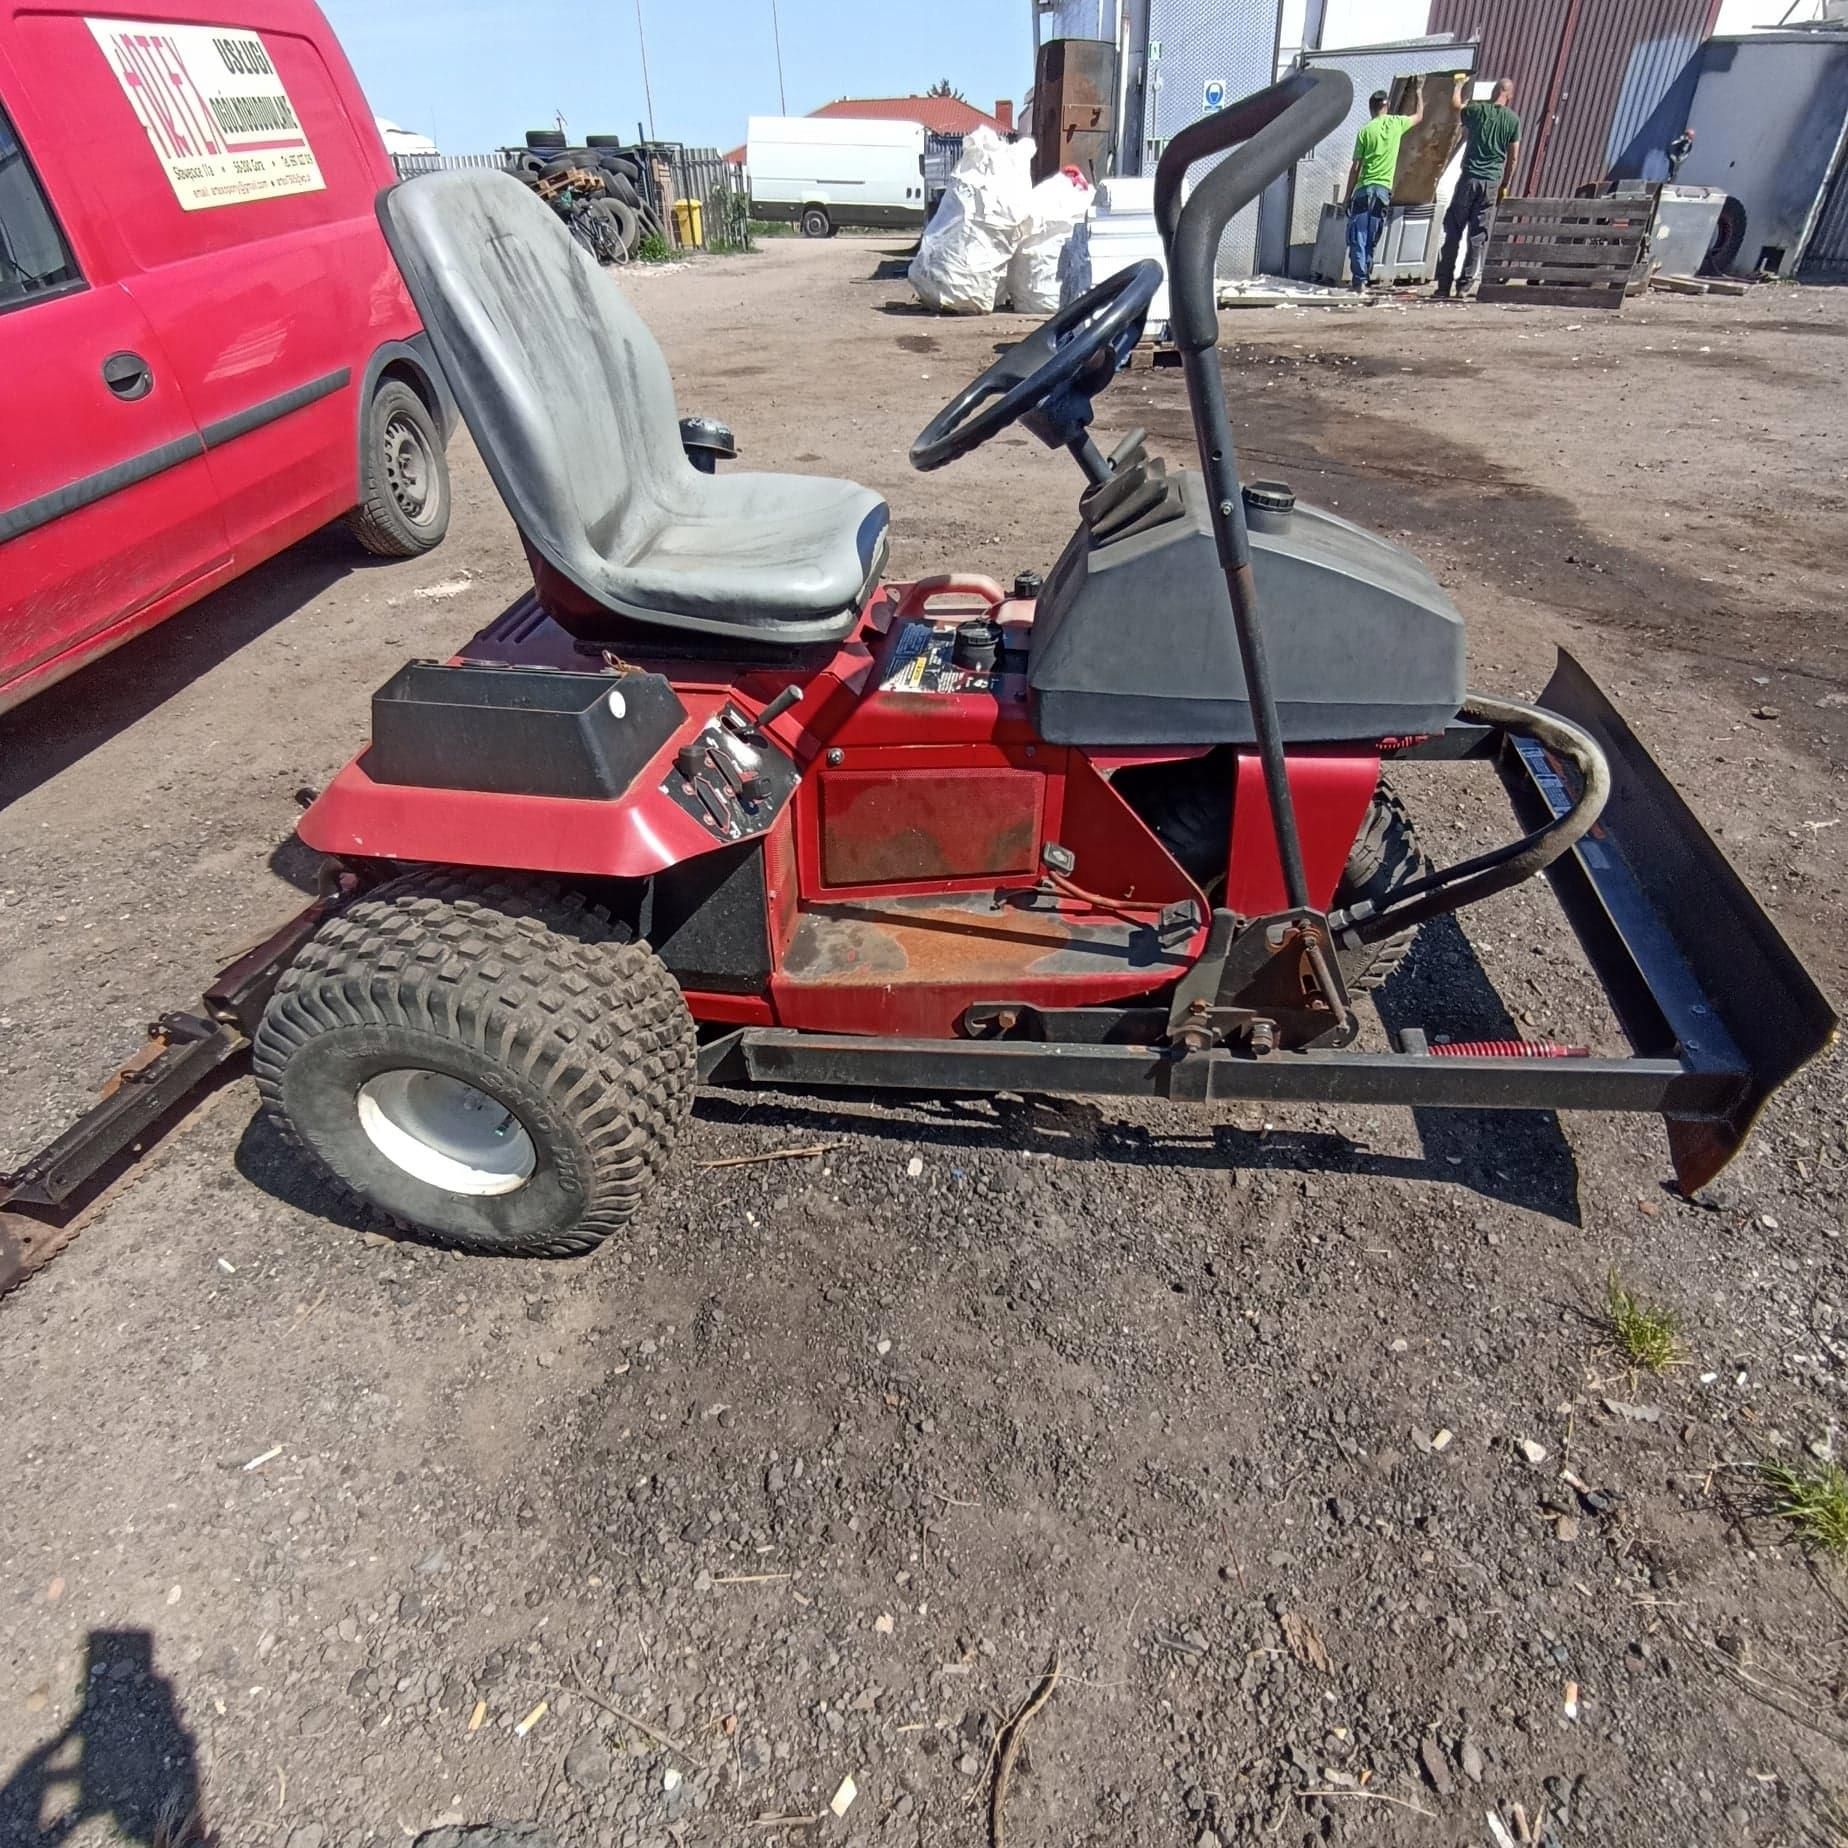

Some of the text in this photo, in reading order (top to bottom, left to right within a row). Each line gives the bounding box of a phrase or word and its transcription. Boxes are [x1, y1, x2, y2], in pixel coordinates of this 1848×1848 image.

[213, 38, 273, 76] USŁUGI
[110, 33, 228, 159] ARTEX
[209, 90, 299, 135] OGÓLNOBUDOWLANE
